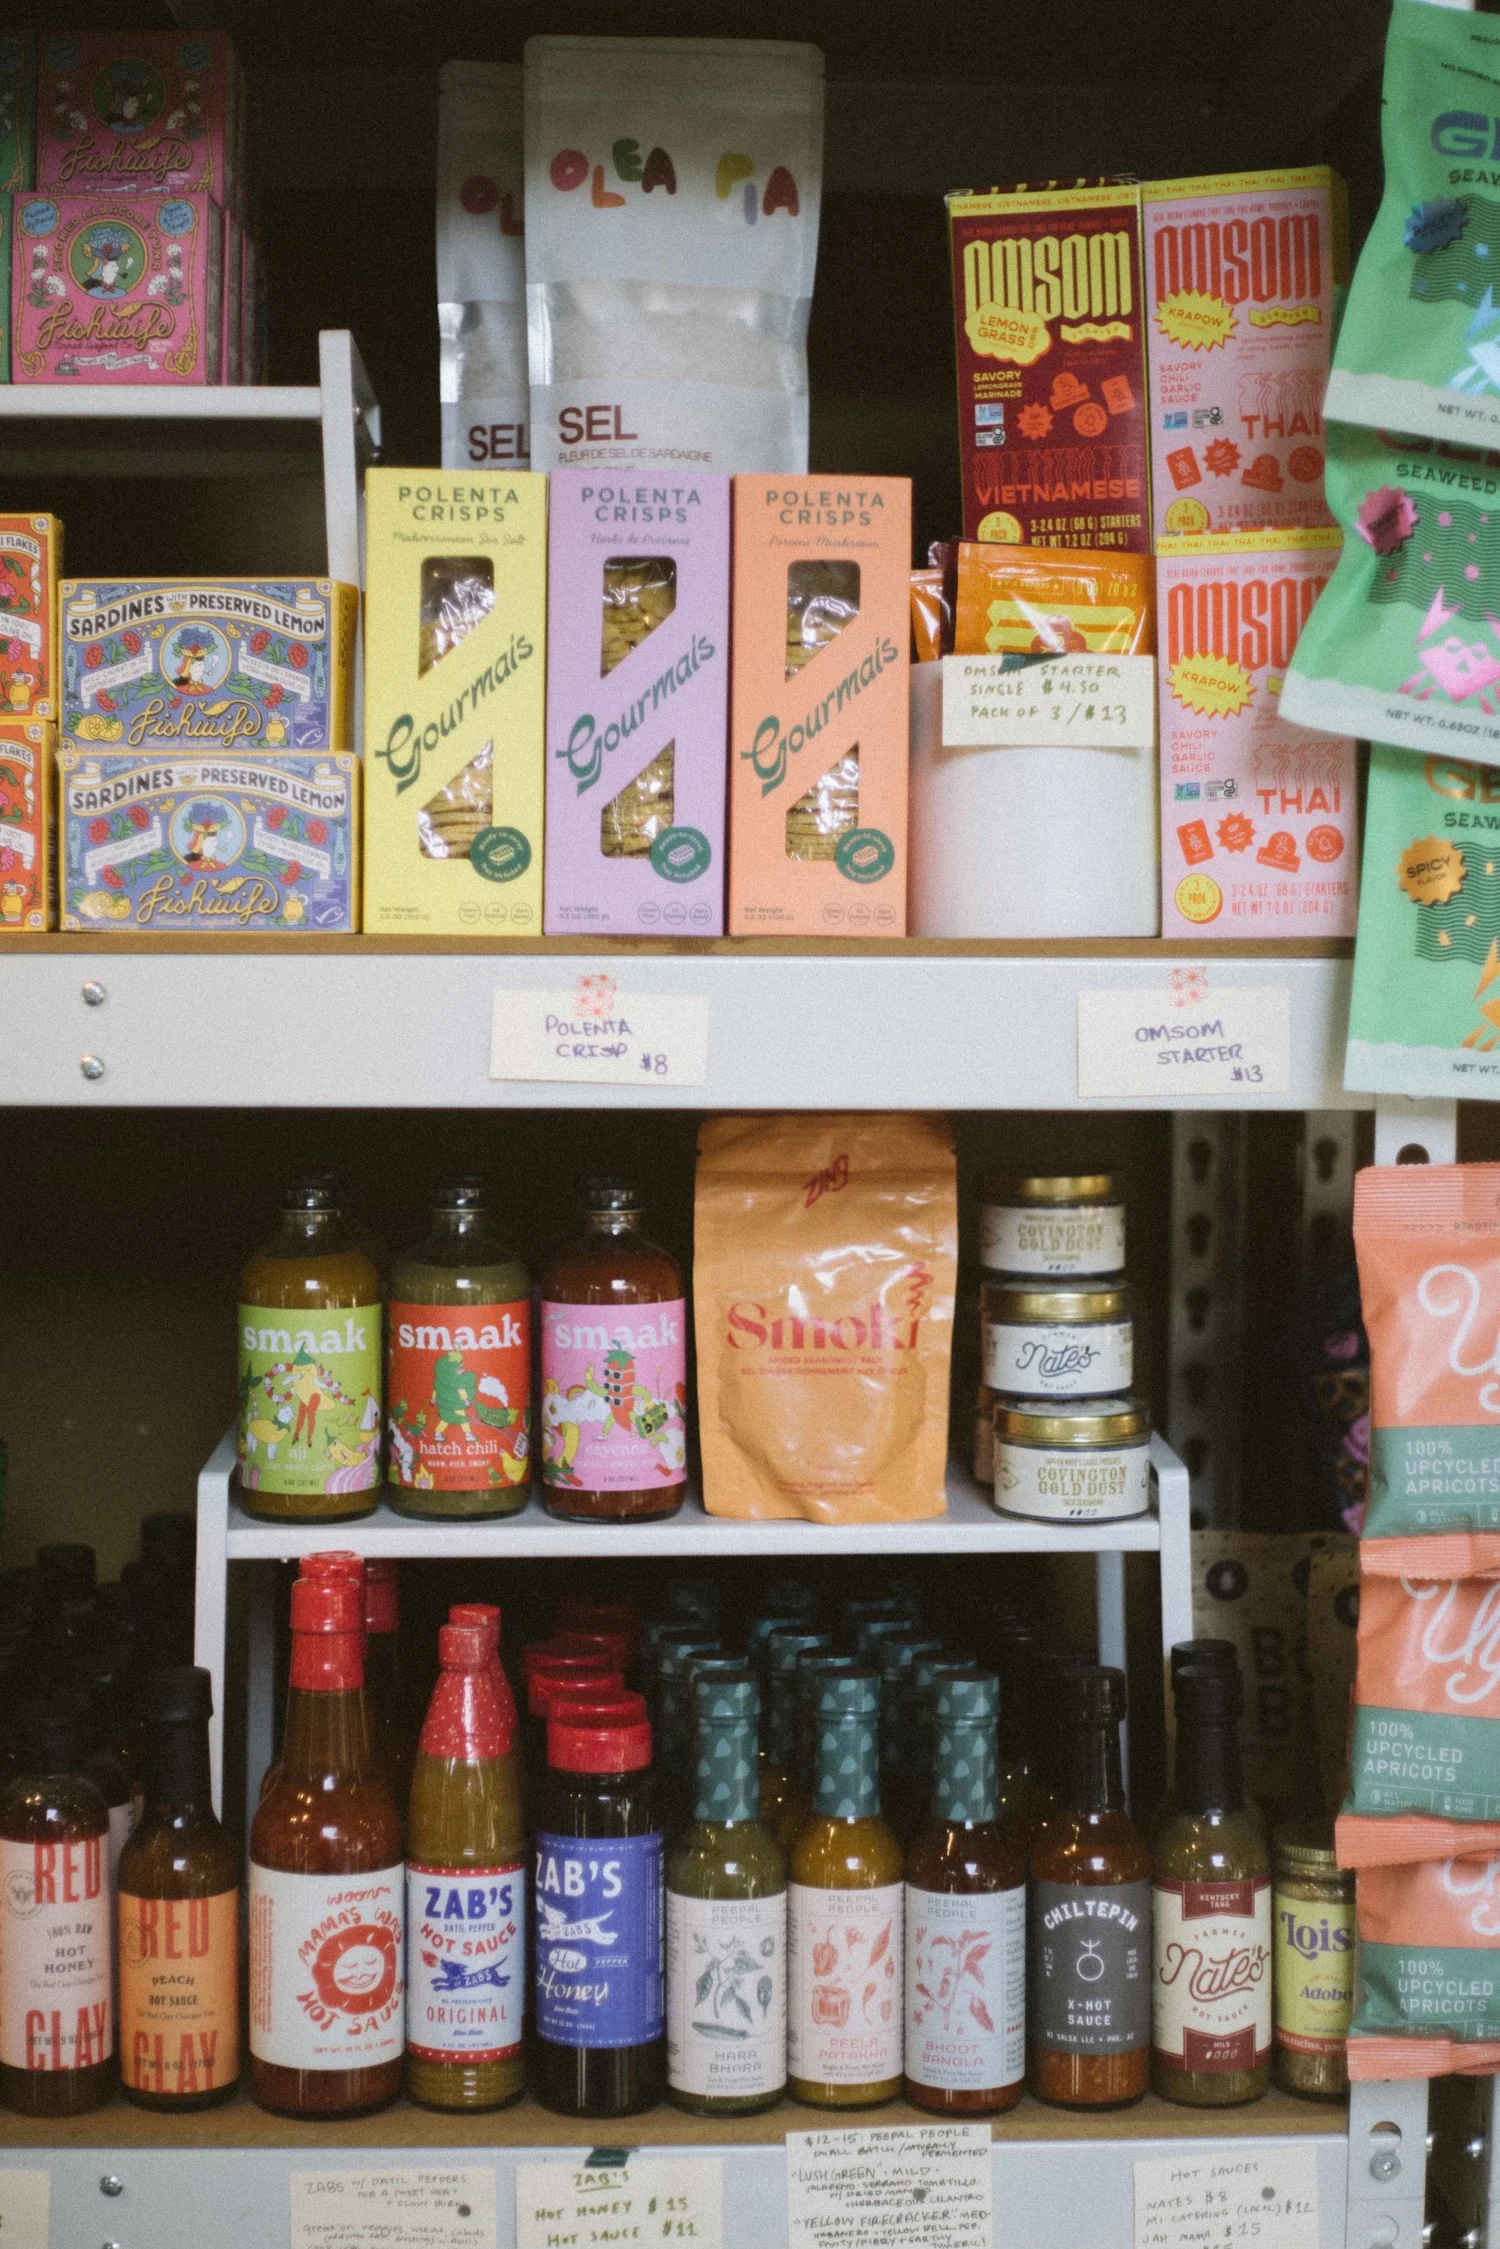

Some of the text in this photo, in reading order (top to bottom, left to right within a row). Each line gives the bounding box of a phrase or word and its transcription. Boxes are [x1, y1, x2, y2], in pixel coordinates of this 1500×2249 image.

[549, 137, 800, 227] OLEA PIA
[979, 314, 1030, 335] LEMON
[1168, 308, 1224, 328] KRAPOW
[977, 327, 1026, 348] GRASS
[1159, 362, 1203, 373] SAVORY
[973, 371, 1023, 383] SAVORY
[1160, 373, 1189, 383] CHILI
[974, 389, 1022, 400] MARINADE
[1160, 383, 1201, 394] GARLIC
[1160, 394, 1198, 405] SAUCE
[558, 404, 639, 445] SEL
[1240, 411, 1321, 441] THAI
[1396, 463, 1498, 495] SEAWEED
[399, 486, 520, 504] POLENTA
[581, 487, 701, 505] POLENTA
[765, 490, 885, 508] POLENTA
[974, 478, 1140, 506] VIETNAMESE
[412, 505, 506, 522] CRISPS
[595, 506, 688, 523] CRISPS
[779, 509, 872, 526] CRISPS
[6, 536, 38, 554] FLAKES
[70, 594, 325, 636] SARDINES WITH PRESERVED LEMON
[1040, 664, 1121, 679] STARTER
[970, 683, 1024, 696] SINGLE
[1181, 671, 1240, 694] KRAPOW
[970, 704, 1061, 720] PACK OF 3
[1386, 707, 1436, 728] NET WT.
[1171, 730, 1218, 740] SAVORY
[1171, 742, 1202, 751] CHILI
[1171, 752, 1216, 762] GARLIC
[1171, 763, 1212, 774] SAUCE
[73, 768, 345, 811] SARDINES PRESERVED LEMON
[1256, 787, 1341, 816] THAI
[1405, 857, 1451, 880] SPICY
[1416, 873, 1448, 886] FLAVOR
[544, 1014, 633, 1037] POLENTA
[1134, 1019, 1225, 1043] OMSOM
[555, 1042, 629, 1059] CRISP
[1156, 1043, 1244, 1066] STARTER
[638, 1052, 669, 1076] $8
[1453, 1062, 1476, 1074] NET
[1229, 1064, 1264, 1084] $13
[243, 1317, 367, 1353] smaak
[399, 1312, 522, 1350] smaak
[554, 1311, 678, 1350] smaak
[288, 1445, 309, 1462] aji
[419, 1439, 499, 1456] hatch chili
[1405, 1441, 1454, 1456] 100%
[1037, 1466, 1128, 1483] COVINGTON
[1038, 1480, 1125, 1497] GOLD DUST
[1405, 1477, 1500, 1495] APRICOTS
[1369, 1720, 1414, 1740] 100%
[1366, 1740, 1463, 1764] UPCYCLED
[1363, 1759, 1457, 1783] APRICOTS
[34, 1838, 101, 1905] RED
[425, 1884, 514, 1920] ZAB'S
[927, 1897, 977, 1909] PEEPAL
[1200, 1892, 1240, 1902] KENTUCKY
[1210, 1900, 1231, 1908] TANG
[712, 1905, 762, 1914] PEEPAL
[828, 1904, 879, 1913] PEOPLE
[927, 1907, 978, 1918] PEOPLE
[1043, 1900, 1139, 1933] CHILTEPIN
[444, 1922, 496, 1933] DATIL PEPPER
[712, 1914, 762, 1924] PEOPLE
[138, 1898, 210, 1960] RED
[298, 1906, 362, 1967] MAMA'S
[1194, 1928, 1246, 1942] FARMER
[1280, 1911, 1352, 1960] Lois
[420, 1920, 518, 1957] HOT SAUCE
[55, 1945, 87, 1959] HOT
[550, 1948, 582, 1970] Hot
[44, 1957, 95, 1975] HONEY
[594, 1958, 629, 1966] PEPPER
[1398, 1959, 1445, 1977] 100%
[151, 1974, 196, 1987] PEACH
[1159, 1942, 1271, 2004] Nate's
[536, 1963, 609, 2007] Honey
[1397, 1979, 1494, 1997] UPCYCLED
[148, 1994, 199, 2007] HOT SAUCE
[1067, 1999, 1113, 2012] X-HOT
[296, 1990, 340, 2032] HOT
[426, 2004, 508, 2025] ORIGINAL
[1191, 2006, 1211, 2021] HOT
[1067, 2014, 1113, 2027] SAUCE
[25, 2000, 107, 2072] CLAY
[829, 2037, 878, 2048] PEELA
[1056, 2033, 1095, 2044] SALSA LLC
[1290, 2037, 1323, 2050] cocina,
[926, 2042, 980, 2054] BHOOT
[1213, 2041, 1231, 2049] MILD
[133, 2030, 218, 2095] CLAY
[714, 2050, 757, 2062] HARA
[819, 2048, 888, 2060] PATAKHA
[922, 2053, 984, 2067] BANGLA
[709, 2062, 762, 2074] BHARA
[870, 2127, 970, 2142] PEEPAL PEOPLE
[572, 2170, 630, 2187] ZAB'S
[891, 2166, 931, 2177] MILD
[1210, 2162, 1259, 2178] SAUCES
[304, 2175, 409, 2195] ZABS DATIL
[576, 2200, 633, 2217] HONEY
[1146, 2196, 1193, 2212] NATES
[1171, 2202, 1282, 2225] CATERING (LOCAL)
[590, 2226, 641, 2243] SAUCE
[1142, 2230, 1212, 2245] JAH MAMA
